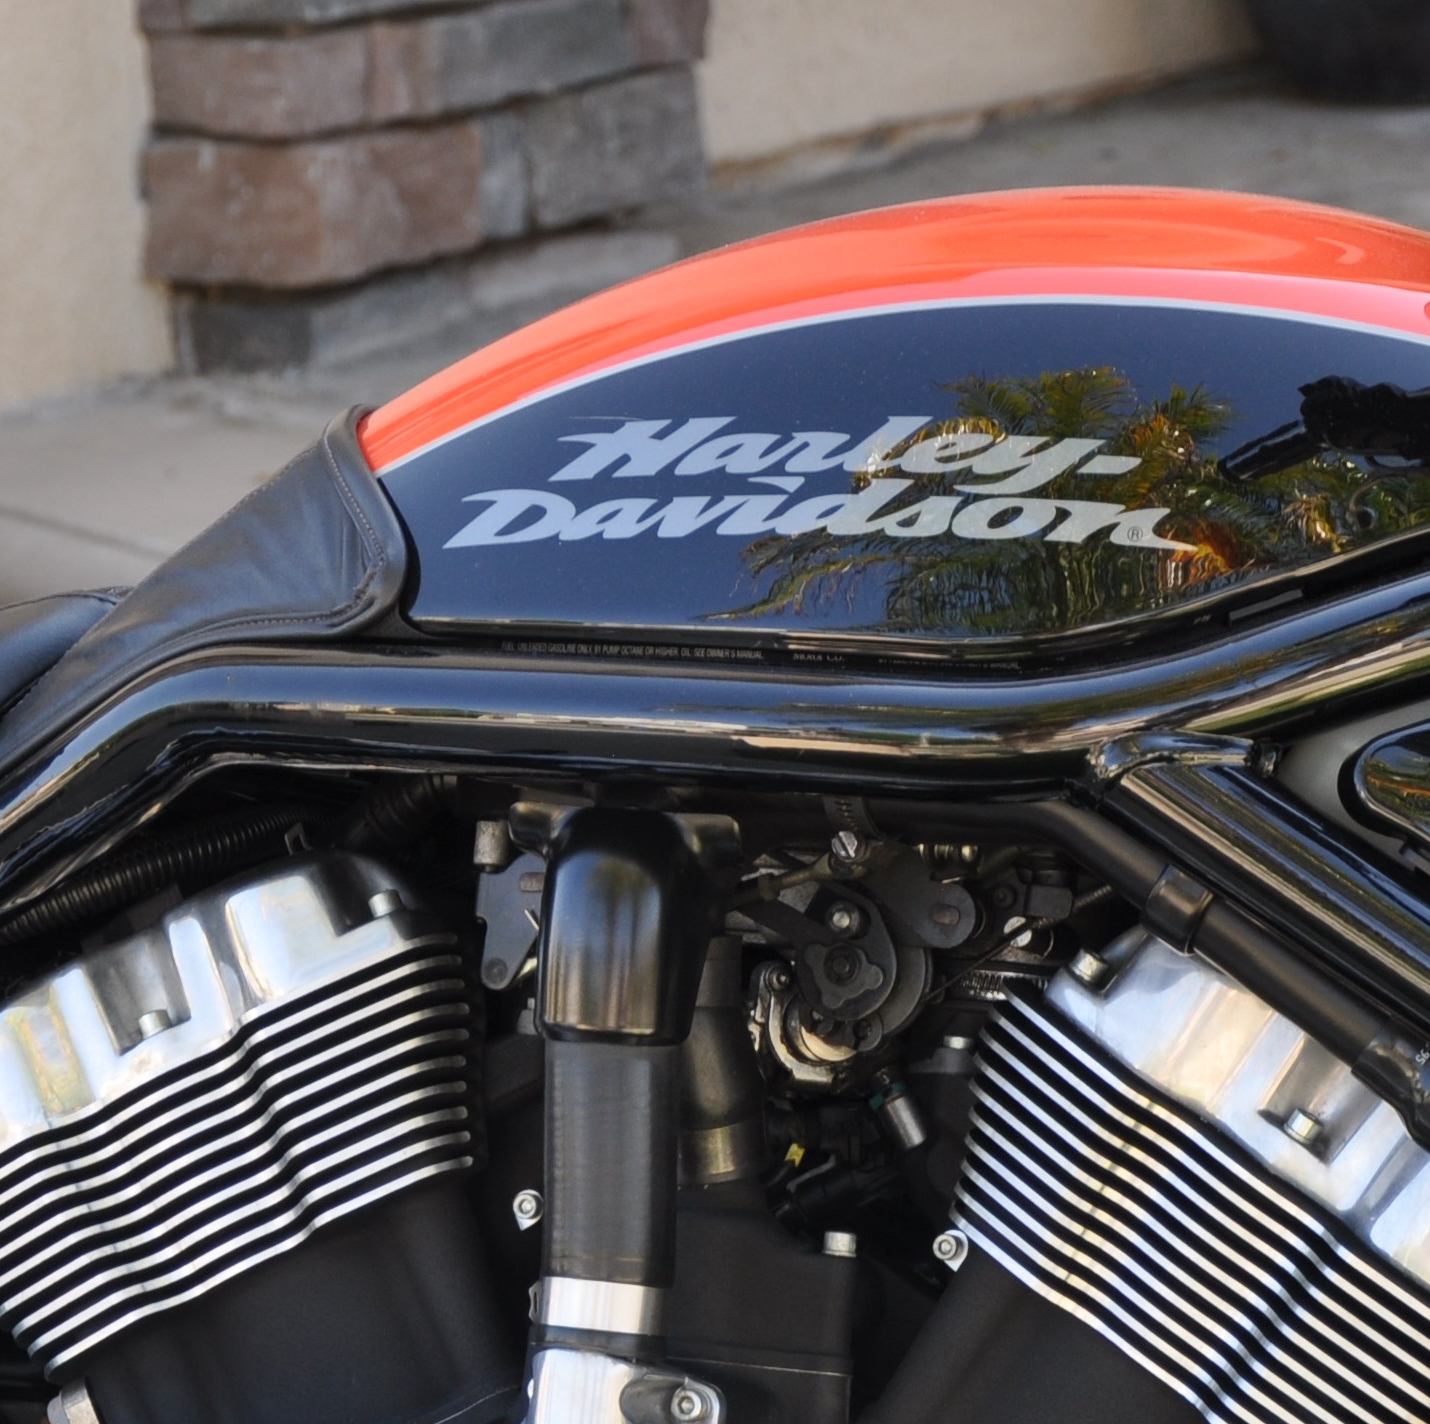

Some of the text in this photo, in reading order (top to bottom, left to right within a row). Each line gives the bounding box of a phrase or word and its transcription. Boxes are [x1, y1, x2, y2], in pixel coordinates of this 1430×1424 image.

[549, 415, 1142, 495] Harley-
[443, 475, 1199, 551] Davidson
[621, 645, 644, 655] OCTANE
